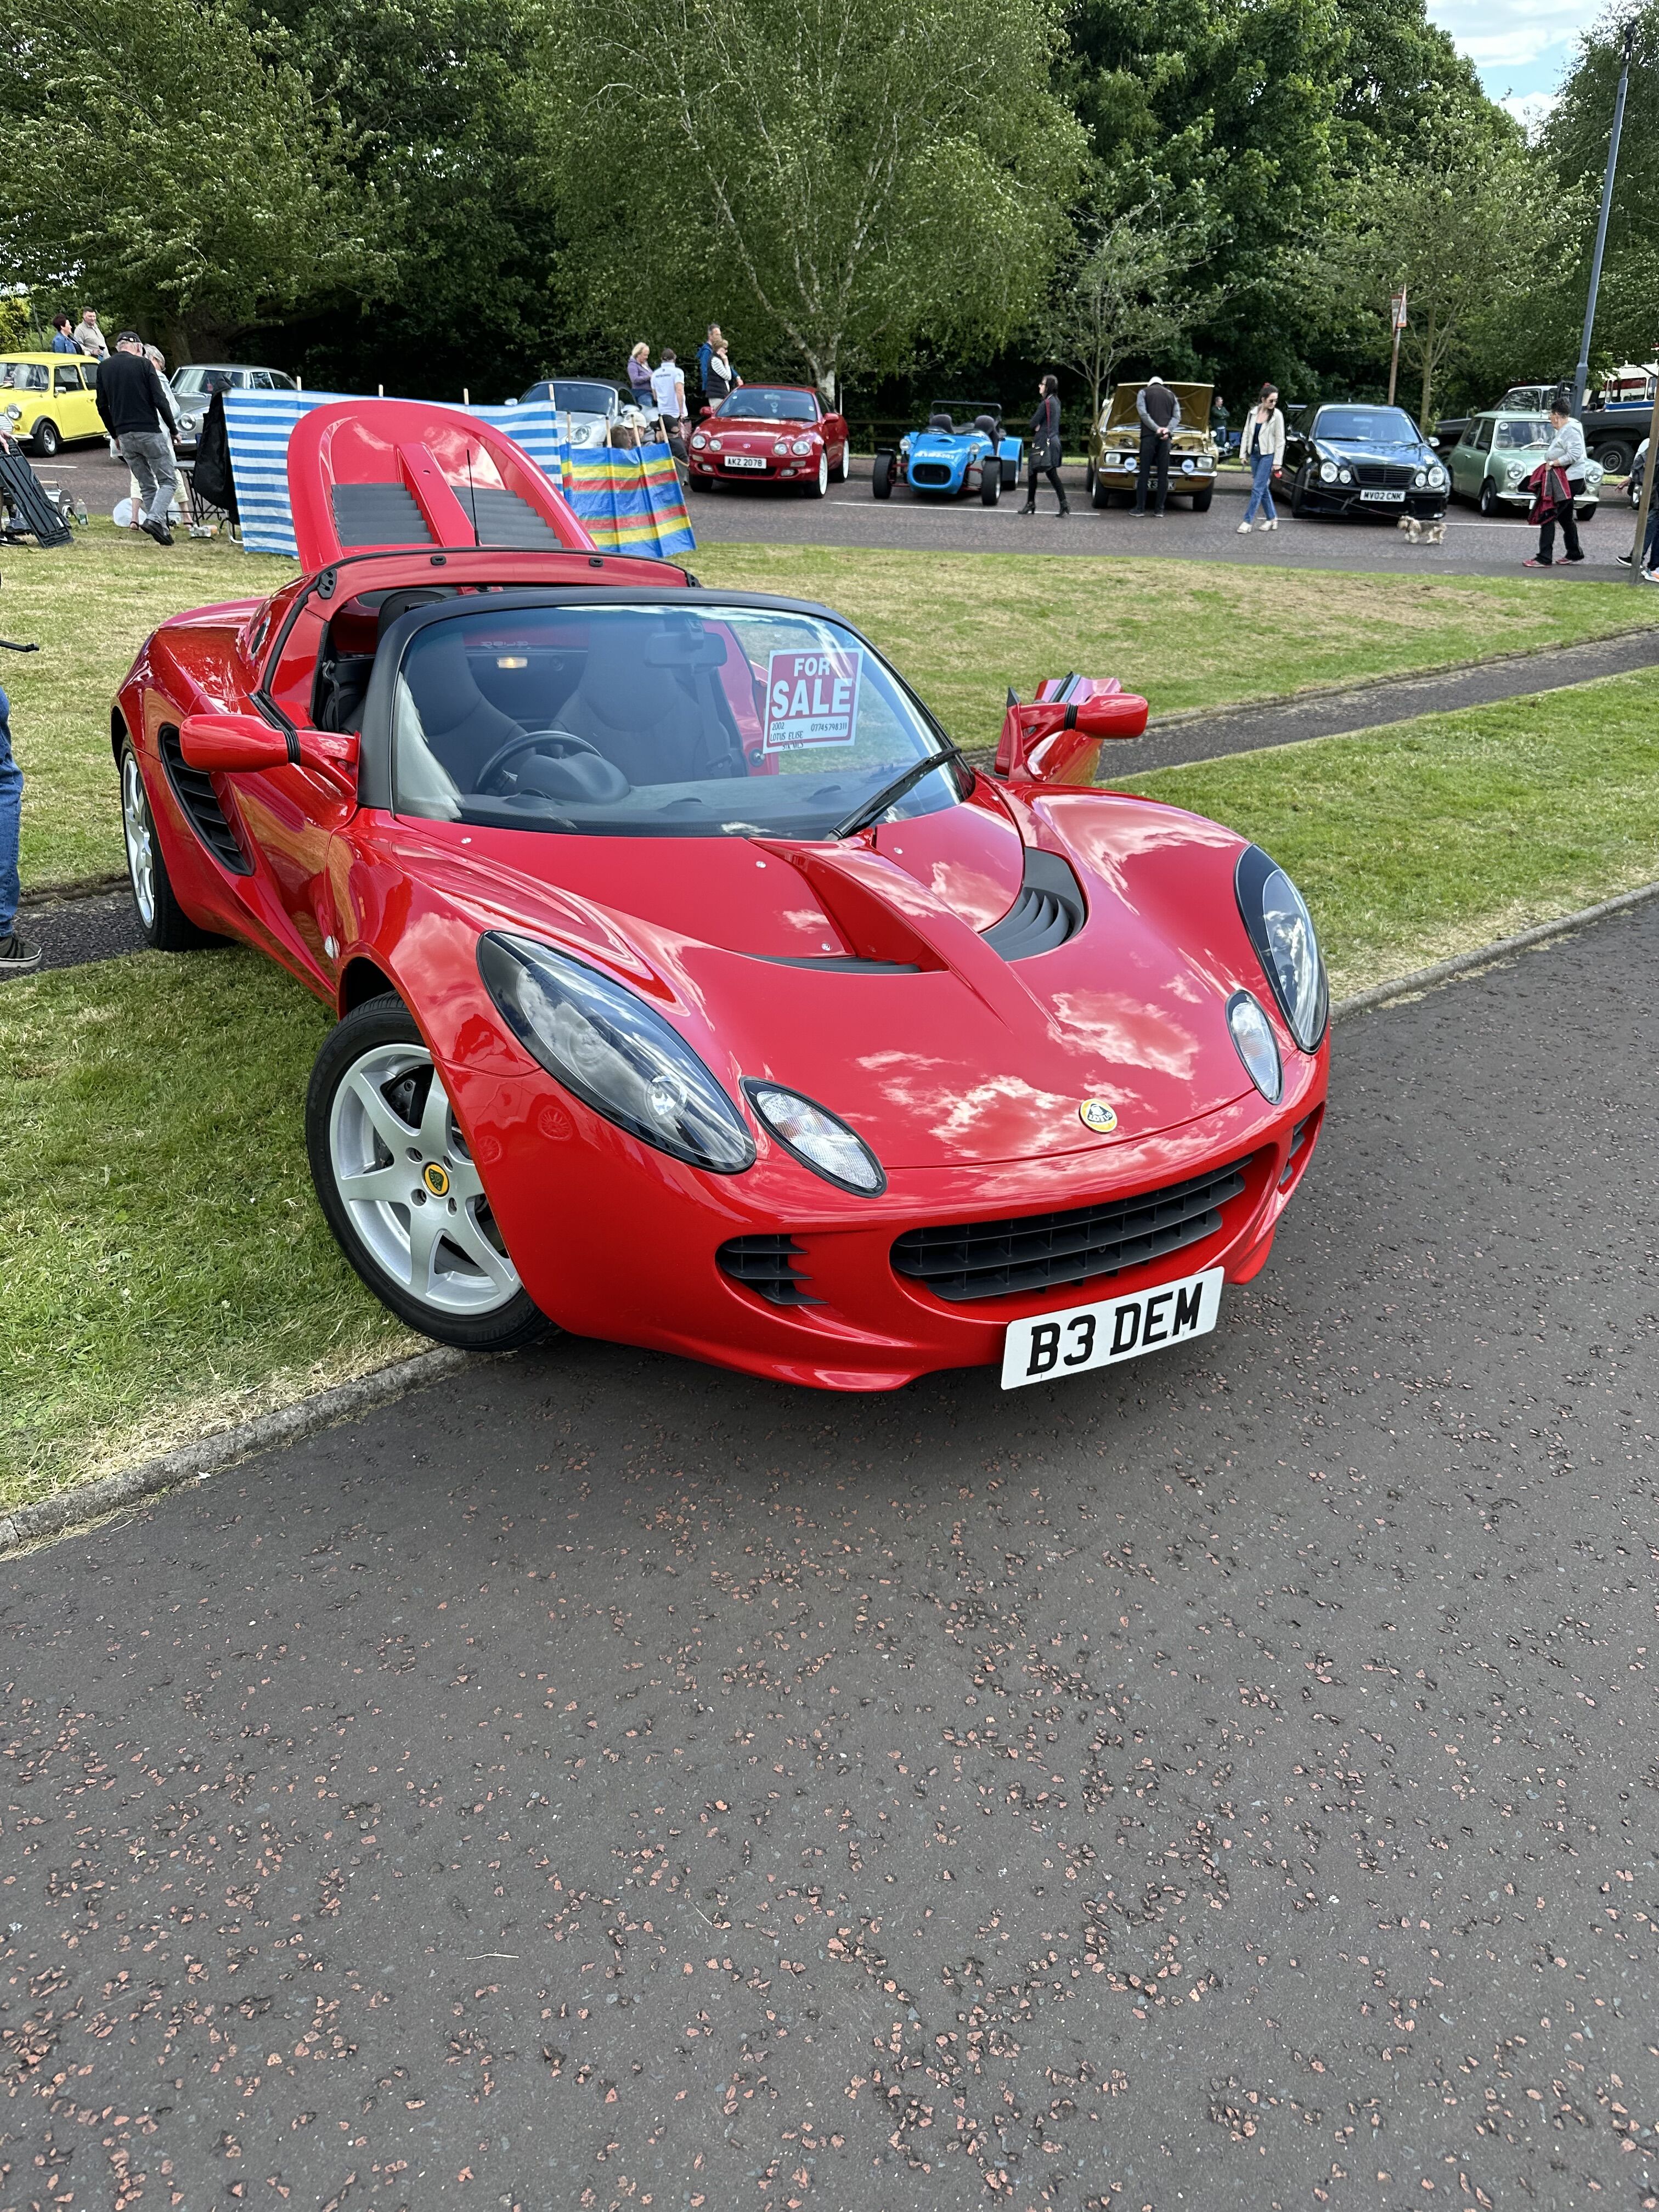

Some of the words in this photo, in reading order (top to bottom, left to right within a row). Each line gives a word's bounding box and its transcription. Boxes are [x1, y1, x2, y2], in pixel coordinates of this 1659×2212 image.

[728, 458, 741, 466] AKZ
[743, 459, 763, 467] 2078
[794, 657, 831, 676] FOR
[771, 678, 853, 719] SALE
[772, 721, 785, 730] 2002
[770, 732, 786, 741] LOTUS
[788, 730, 803, 740] ELISE
[1088, 1111, 1112, 1122] LOTUS
[1026, 1313, 1096, 1376] B3
[1109, 1282, 1204, 1356] DEM
